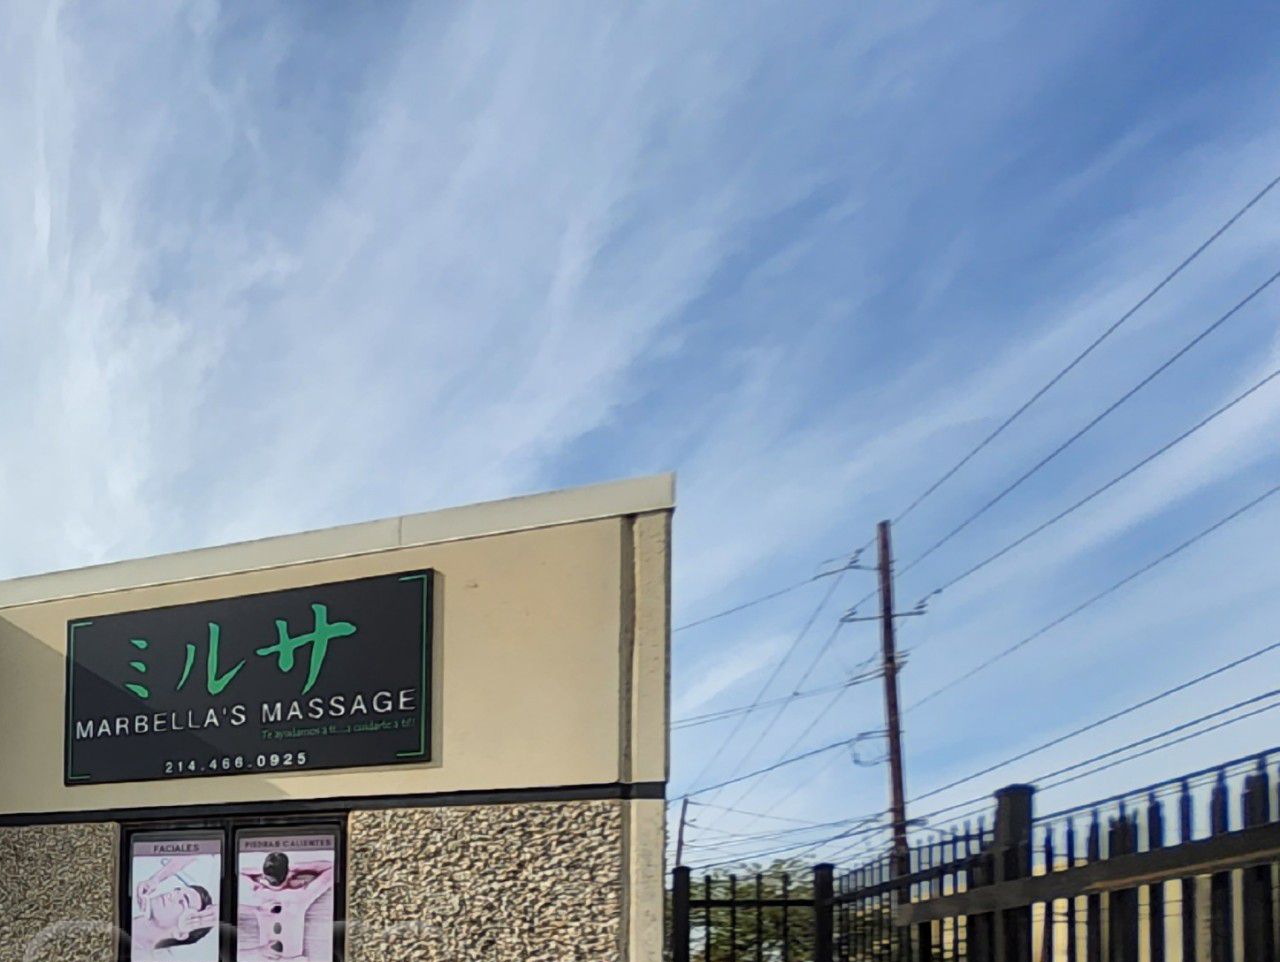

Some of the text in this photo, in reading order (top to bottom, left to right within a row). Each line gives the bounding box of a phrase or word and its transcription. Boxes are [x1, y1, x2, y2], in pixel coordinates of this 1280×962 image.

[75, 688, 416, 740] MARBELLA'S MASSAGE
[164, 752, 307, 774] 214.466.0925
[153, 843, 200, 853] FACIALES
